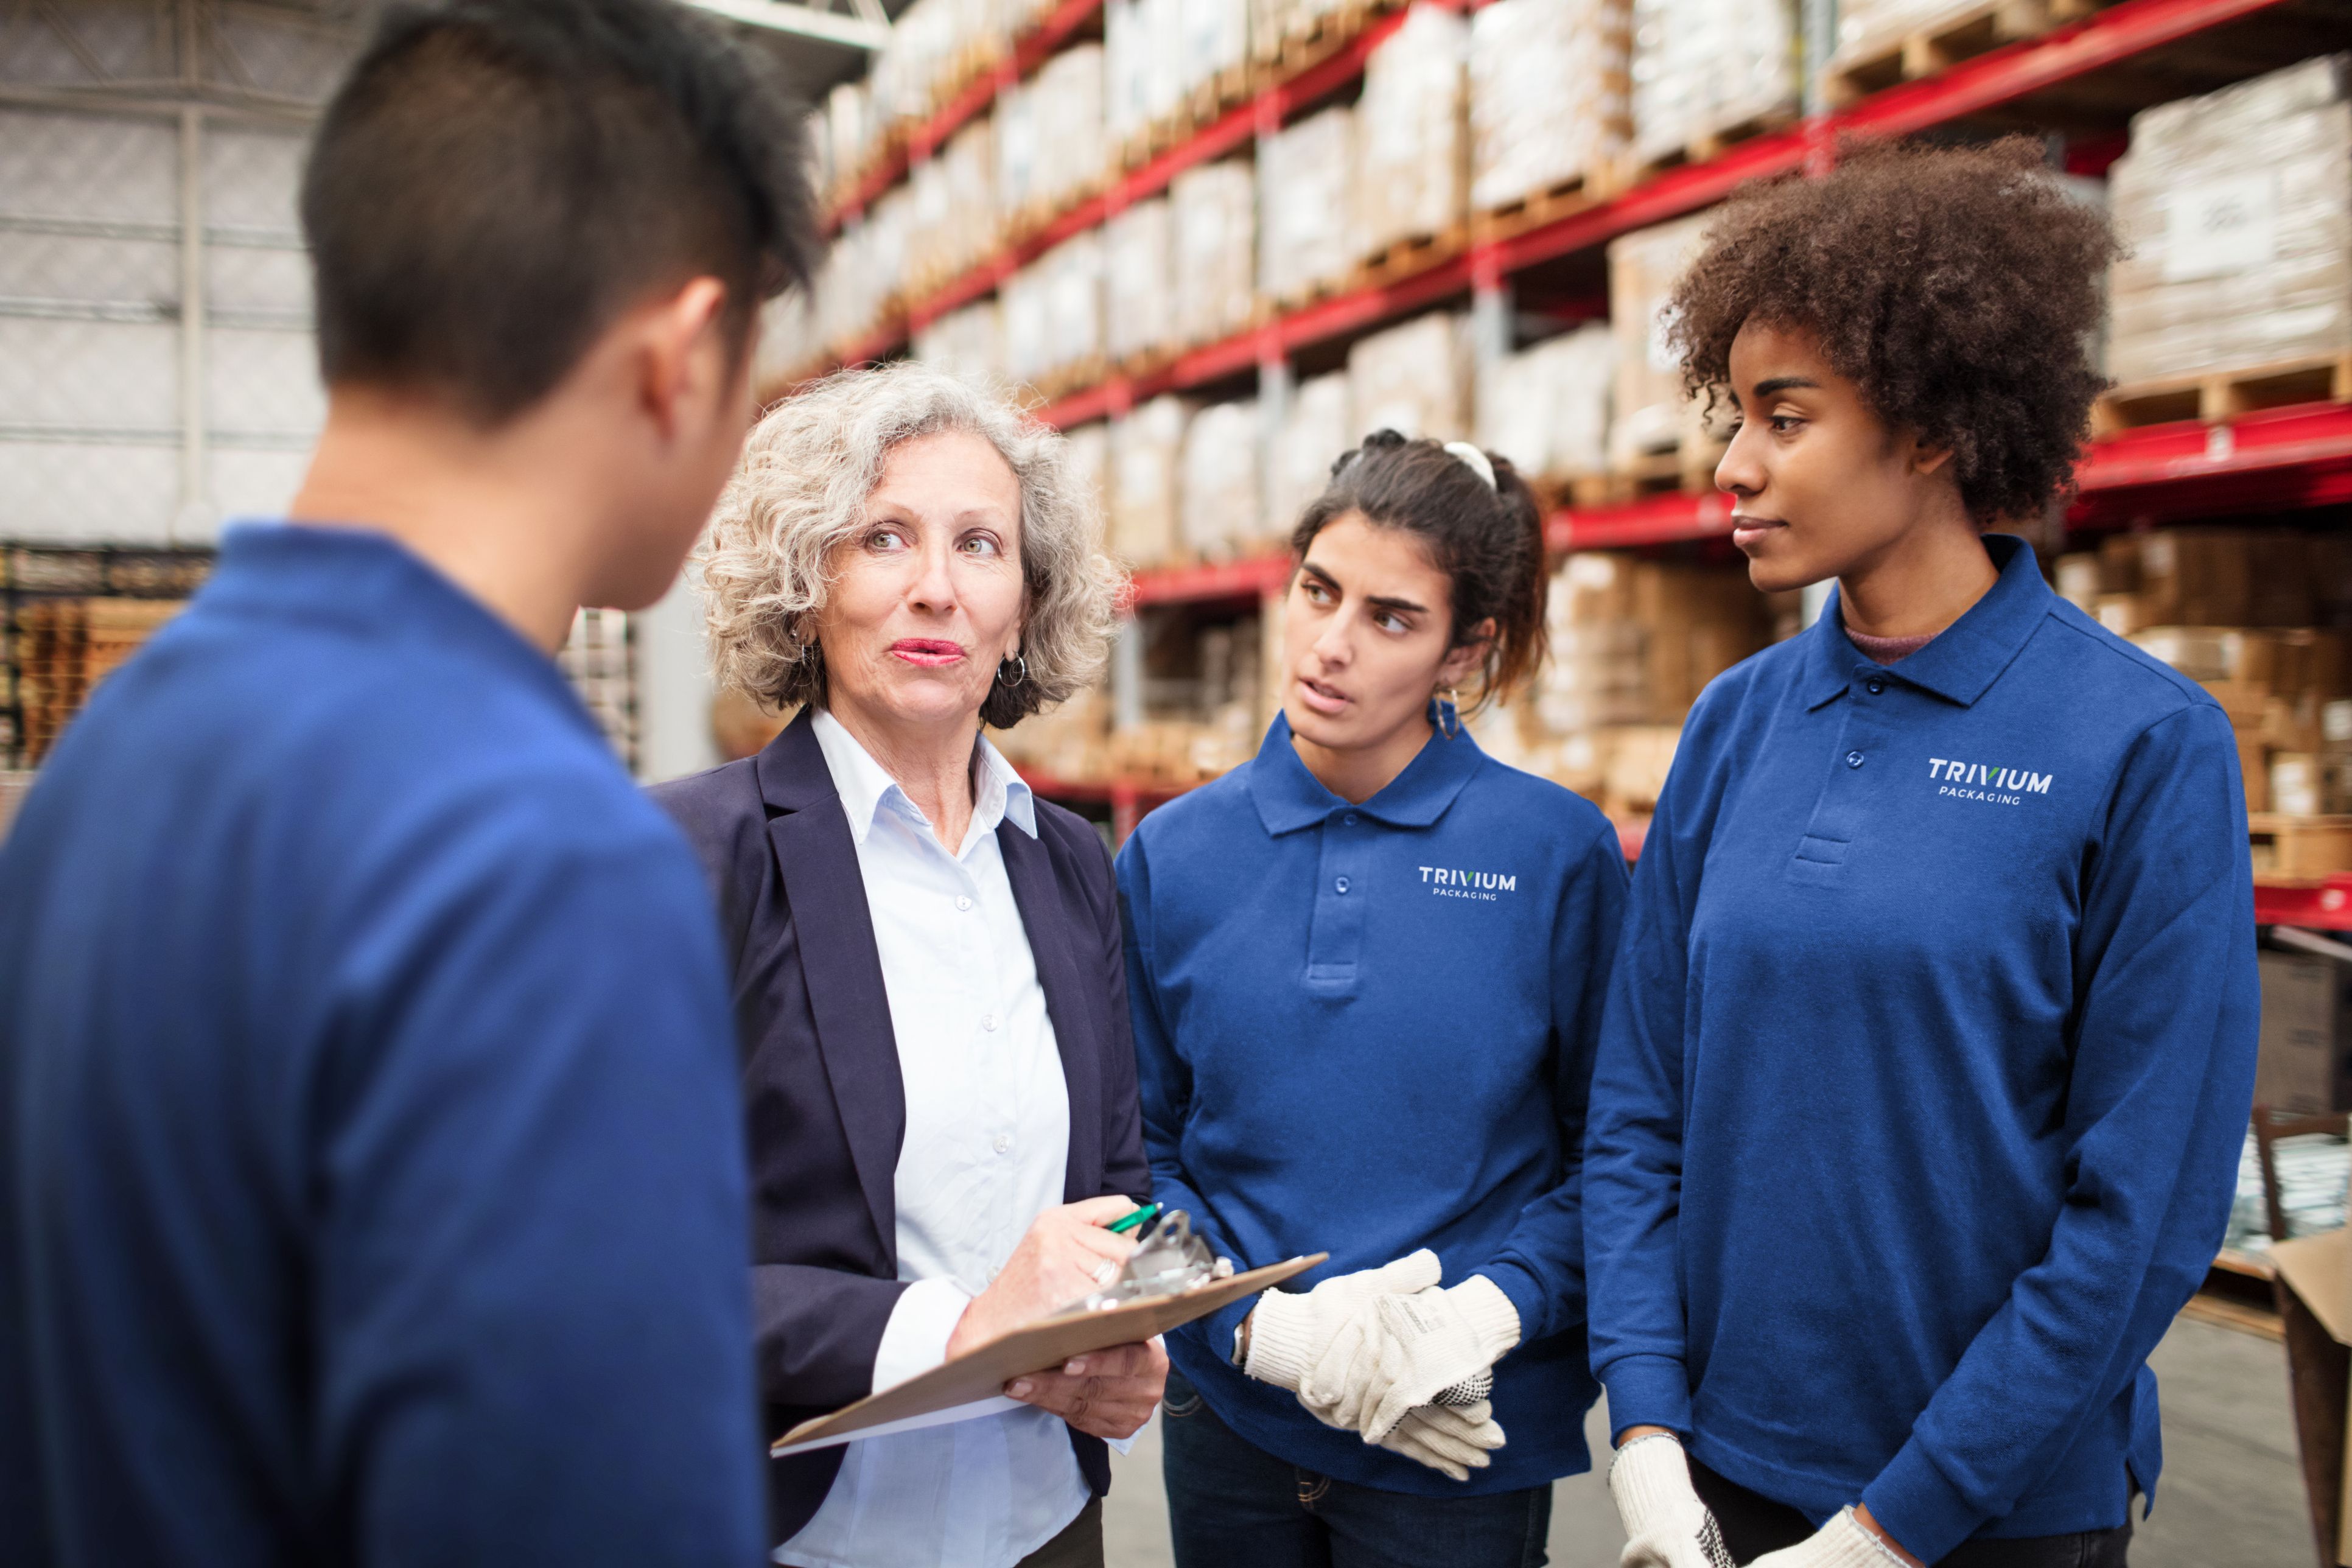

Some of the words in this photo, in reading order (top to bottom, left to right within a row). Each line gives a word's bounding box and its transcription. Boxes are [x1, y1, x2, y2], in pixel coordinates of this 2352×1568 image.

[1928, 758, 2053, 794] TRIVIUM
[1939, 786, 2020, 805] PACKAGING
[1419, 866, 1516, 891] TRIVIUM
[1433, 887, 1497, 901] PACKAGING
